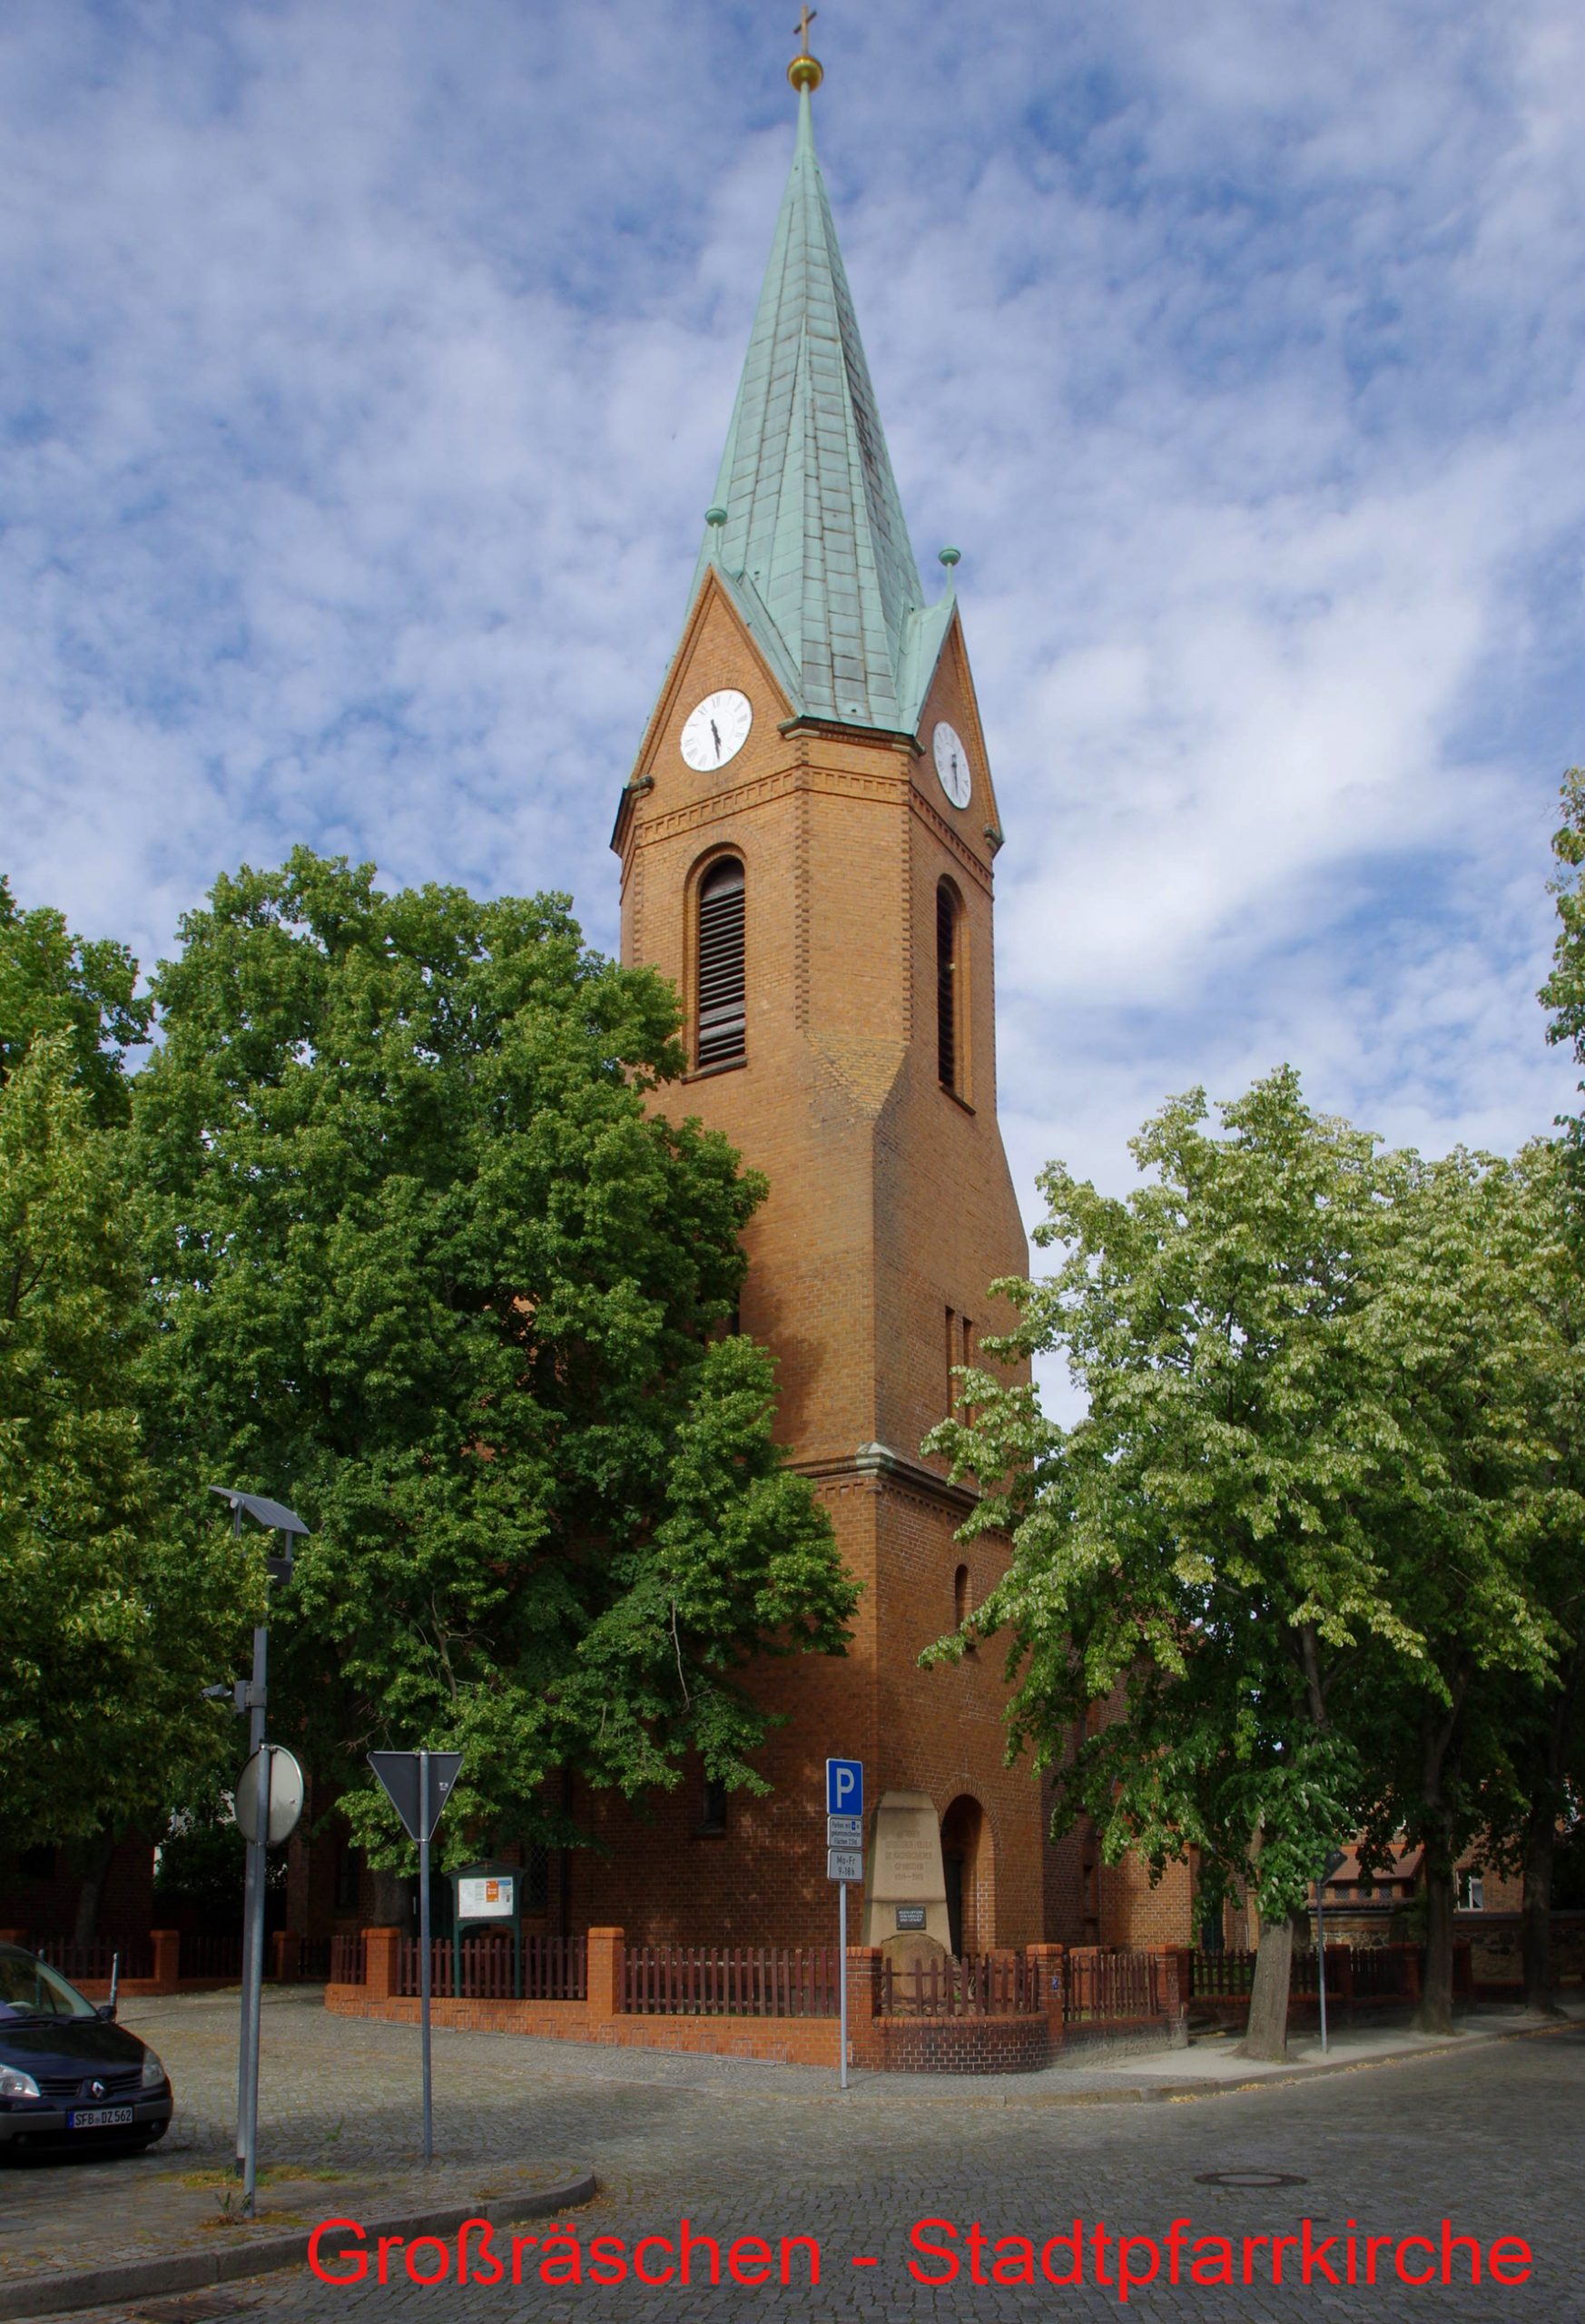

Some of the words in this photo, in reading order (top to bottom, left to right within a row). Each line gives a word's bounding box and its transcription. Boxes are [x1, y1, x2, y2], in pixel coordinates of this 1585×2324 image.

[836, 1767, 855, 1808] P
[836, 1855, 855, 1865] Mo-Fr
[75, 2113, 94, 2126] SFB
